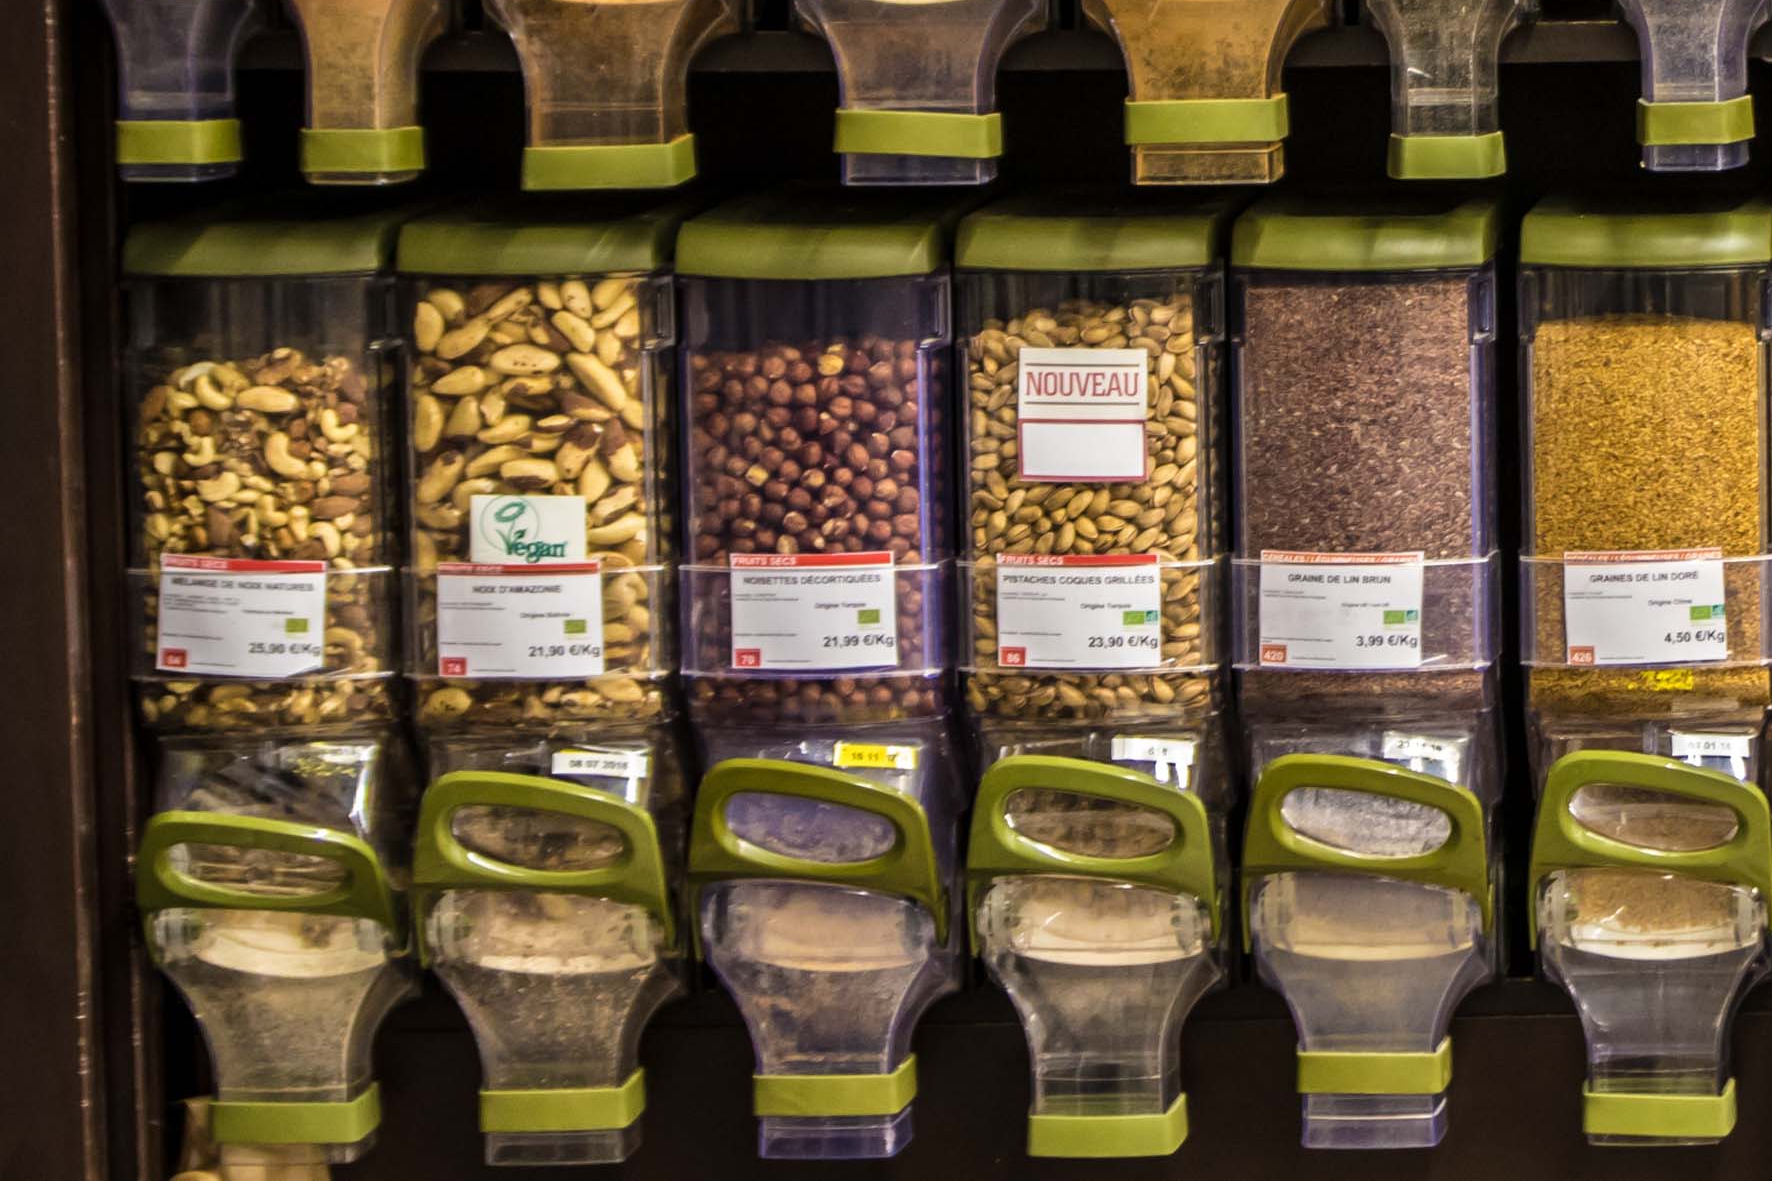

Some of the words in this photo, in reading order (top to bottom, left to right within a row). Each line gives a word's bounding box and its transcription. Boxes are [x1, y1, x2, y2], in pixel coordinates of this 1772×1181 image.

[1025, 371, 1139, 397] NOUVEAU
[497, 530, 567, 563] Vegan
[733, 557, 767, 566] FRUITS
[770, 556, 797, 565] SECS
[1001, 555, 1035, 565] FRUITS
[1038, 555, 1063, 565] SECS
[743, 575, 799, 586] NOISETTES
[1002, 574, 1057, 586] PISTACHES
[1058, 575, 1103, 586] COQUES
[1287, 573, 1325, 584] GRAINE
[1326, 574, 1341, 584] DE
[1343, 575, 1361, 584] LIN
[1361, 575, 1392, 585] BRUN
[1589, 573, 1634, 584] GRAINES
[1635, 573, 1649, 583] DE
[1651, 573, 1669, 582] LIN
[823, 634, 861, 649] 21,99
[862, 635, 895, 647] €/Kg
[1087, 635, 1125, 649] 23,90
[1127, 636, 1158, 648] €/Kg
[1355, 634, 1385, 648] 3,99
[1387, 635, 1417, 648] €/Kg
[1663, 631, 1692, 645] 4,50
[1695, 631, 1725, 643] €/Kg
[528, 645, 566, 658] 21,90
[569, 644, 600, 657] €/Kg
